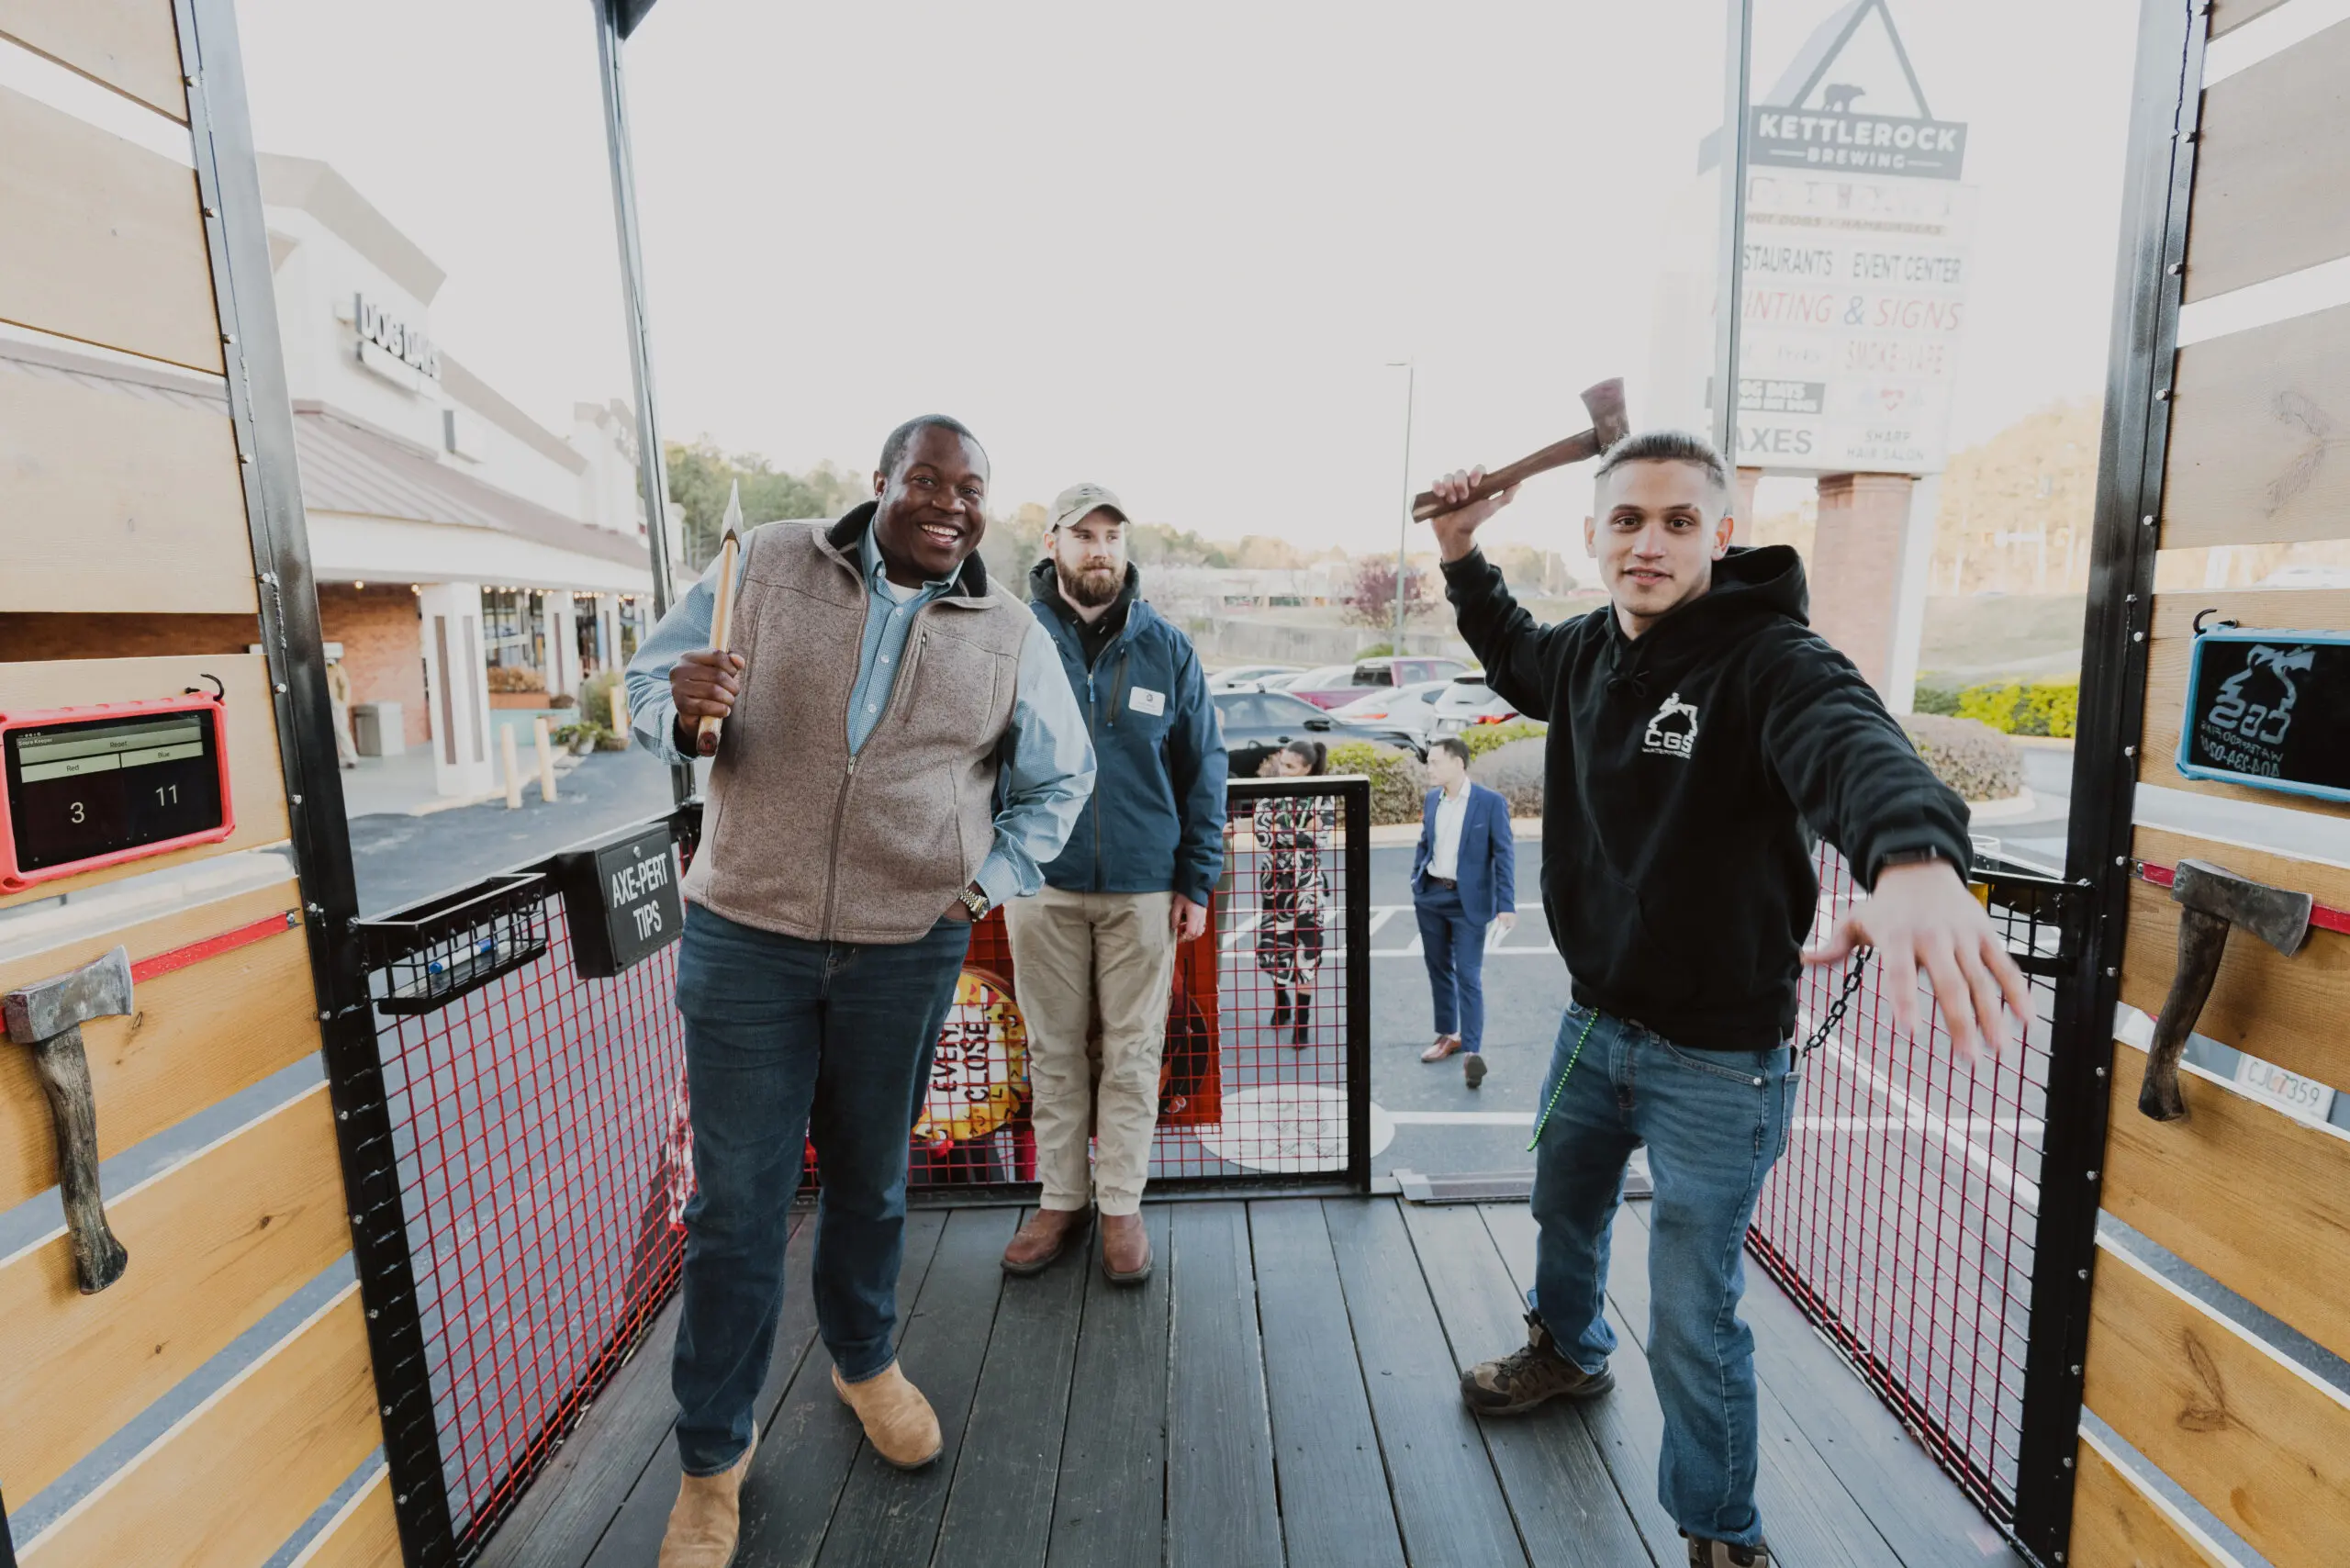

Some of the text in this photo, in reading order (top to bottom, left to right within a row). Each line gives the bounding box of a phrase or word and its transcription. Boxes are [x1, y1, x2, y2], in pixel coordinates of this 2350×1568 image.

[1758, 113, 1959, 152] KETTLEROCK
[1807, 147, 1906, 169] BREWING
[1742, 243, 1963, 283] STAURANTS EVENT CENTER
[1843, 295, 1865, 326] &
[1874, 298, 1964, 331] SIGNS
[1644, 729, 1695, 754] CGS
[70, 784, 178, 823] 3 11
[612, 853, 668, 908] AXE-PERT
[633, 900, 662, 941] TIPS
